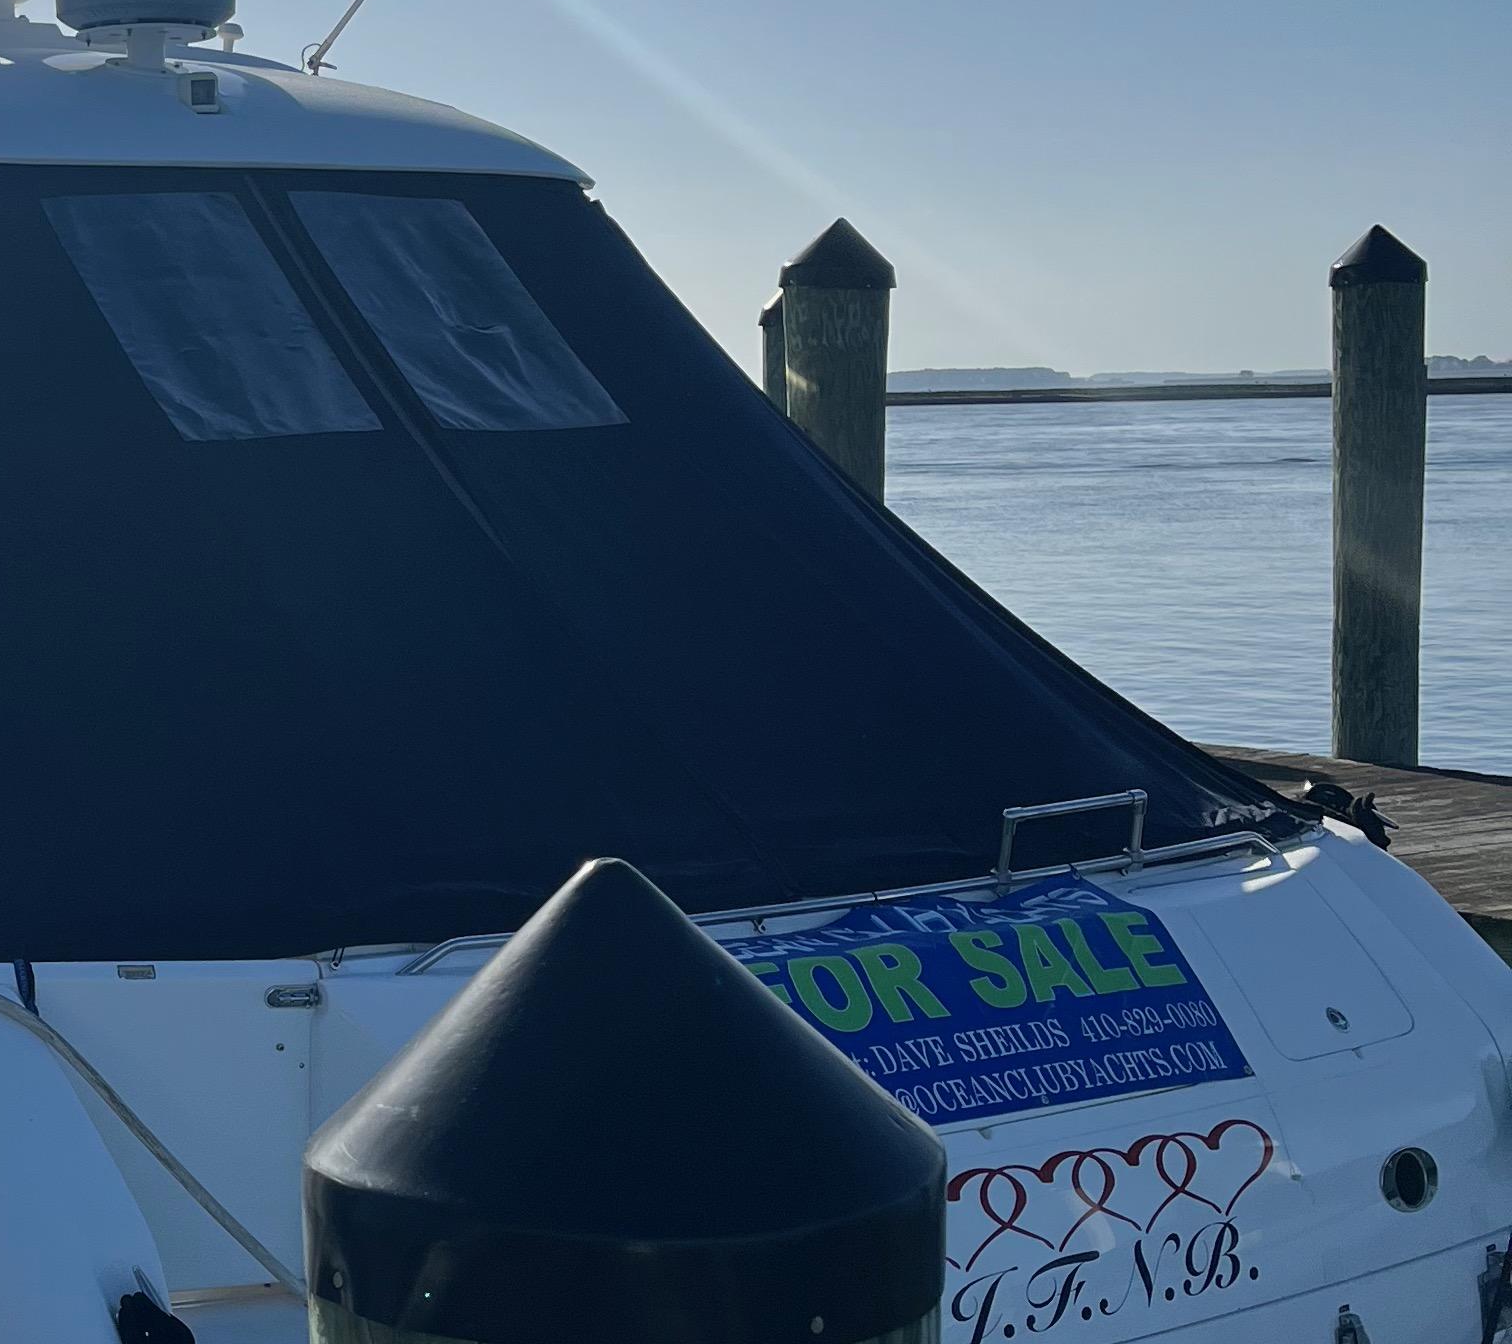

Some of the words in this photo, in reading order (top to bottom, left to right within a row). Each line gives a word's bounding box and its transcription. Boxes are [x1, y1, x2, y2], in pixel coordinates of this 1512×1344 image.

[948, 911, 1188, 1009] SALE
[868, 1036, 955, 1075] DAVE
[953, 1018, 1071, 1063] SHEILDS
[1080, 1000, 1218, 1043] 410-829-0080
